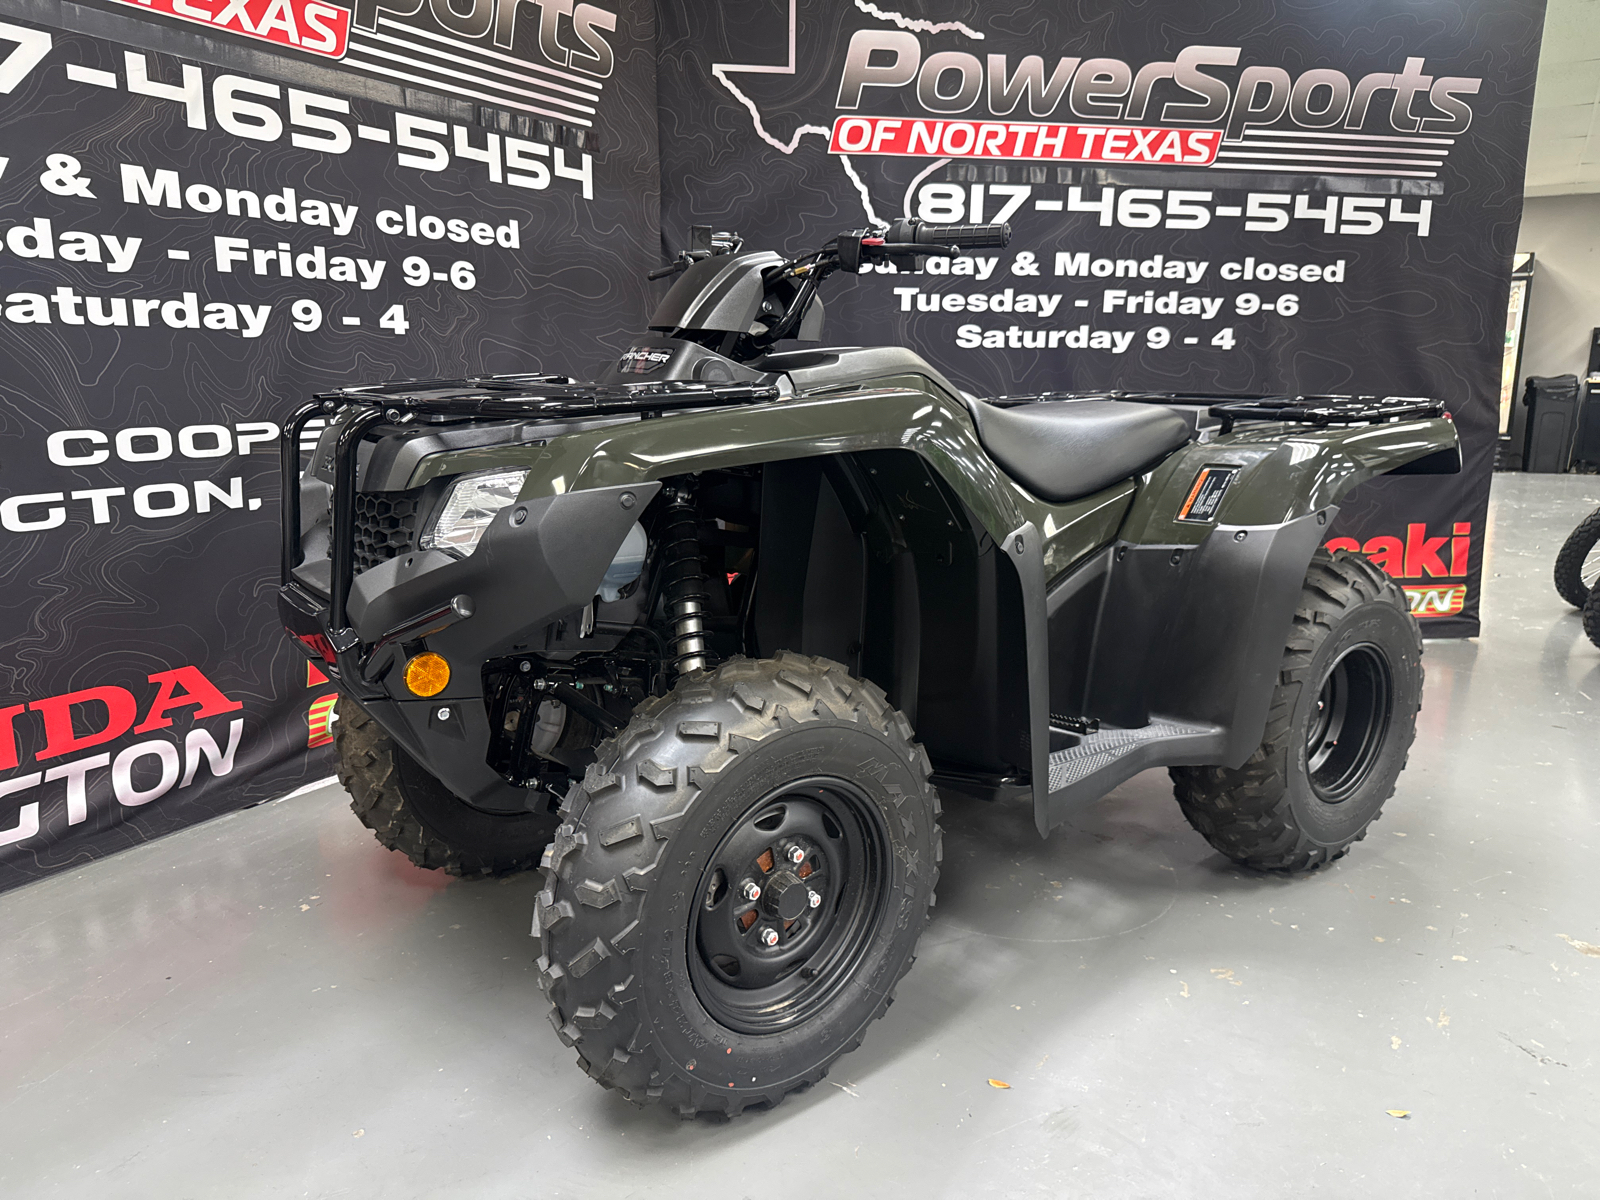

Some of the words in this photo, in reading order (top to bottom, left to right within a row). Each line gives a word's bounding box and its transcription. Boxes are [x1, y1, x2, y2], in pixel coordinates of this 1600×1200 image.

[835, 29, 1483, 142] PowerSports
[837, 118, 903, 152] OF
[906, 122, 1075, 158] NORTH
[1079, 127, 1215, 162] TEXAS
[39, 153, 97, 199] &
[120, 163, 359, 236] Monday
[375, 204, 520, 249] closed
[917, 184, 1433, 237] 817-465-5454
[0, 217, 143, 273] day
[214, 235, 387, 290] Friday
[402, 255, 476, 291] 9-6
[1010, 251, 1040, 276] &
[1054, 252, 1209, 284] Monday
[1220, 257, 1346, 283] closed
[0, 286, 272, 338] aturday
[291, 299, 323, 332] 9
[379, 304, 410, 335] 4
[893, 287, 1063, 318] Tuesday
[1102, 289, 1225, 320] Friday
[1235, 292, 1299, 317] 9-6
[955, 324, 1135, 354] Saturday
[1146, 326, 1171, 350] 9
[1211, 327, 1236, 350] 4
[46, 418, 326, 467] COOPE
